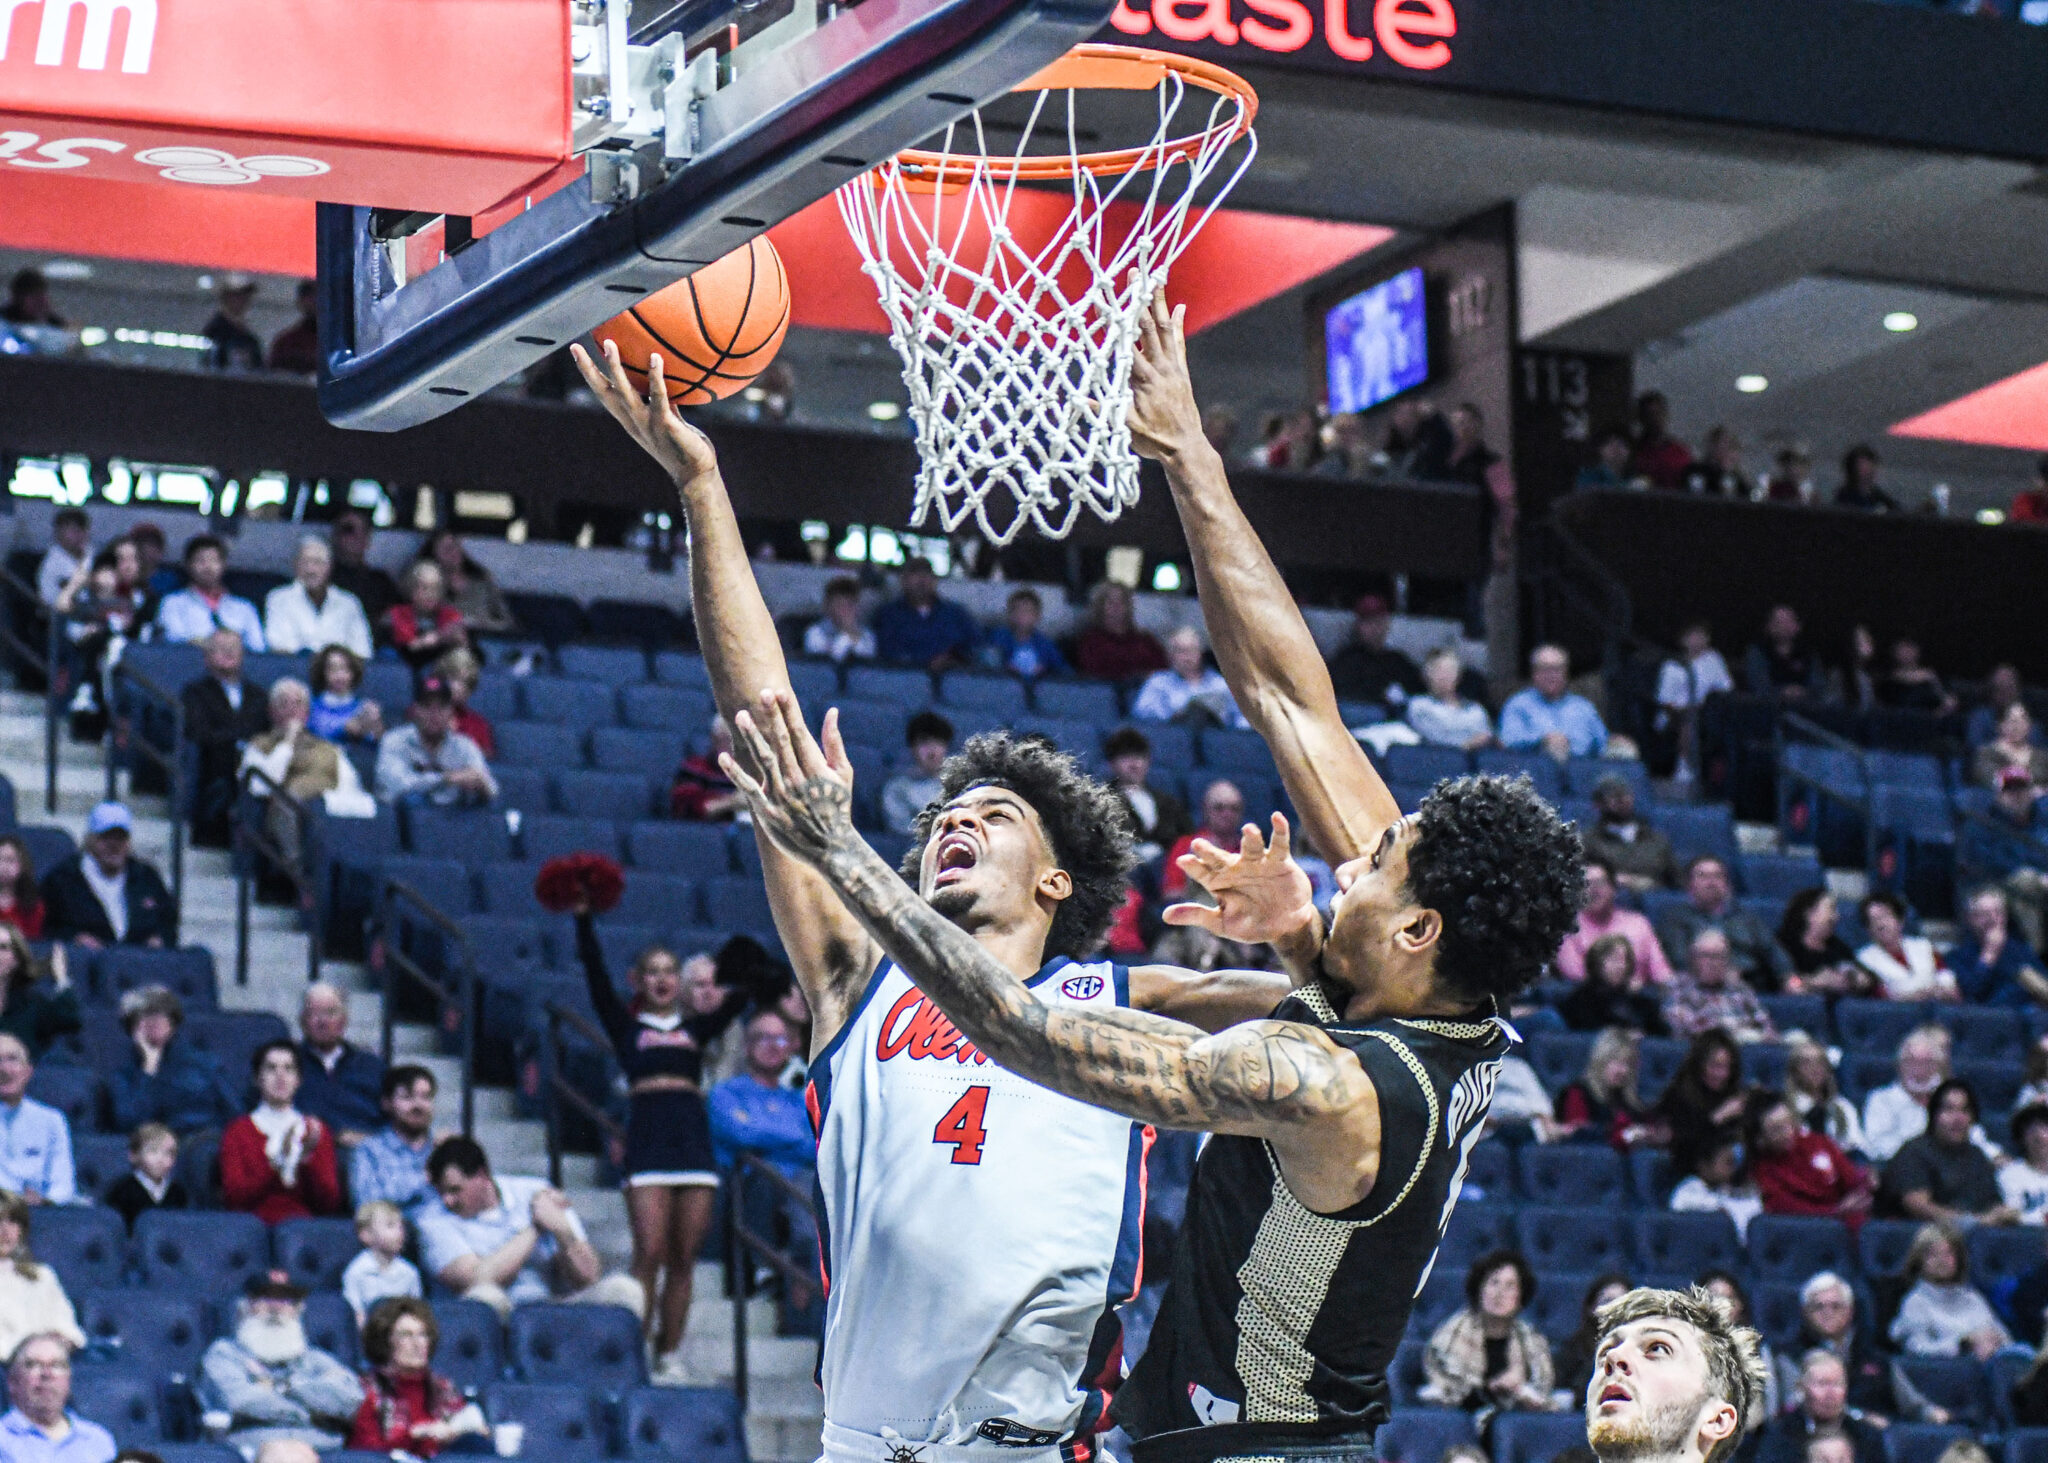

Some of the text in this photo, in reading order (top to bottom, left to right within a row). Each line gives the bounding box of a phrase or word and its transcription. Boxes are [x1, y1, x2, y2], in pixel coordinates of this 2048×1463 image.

[1522, 357, 1590, 407] 113
[1065, 977, 1102, 999] SEC
[932, 1085, 991, 1166] 4
